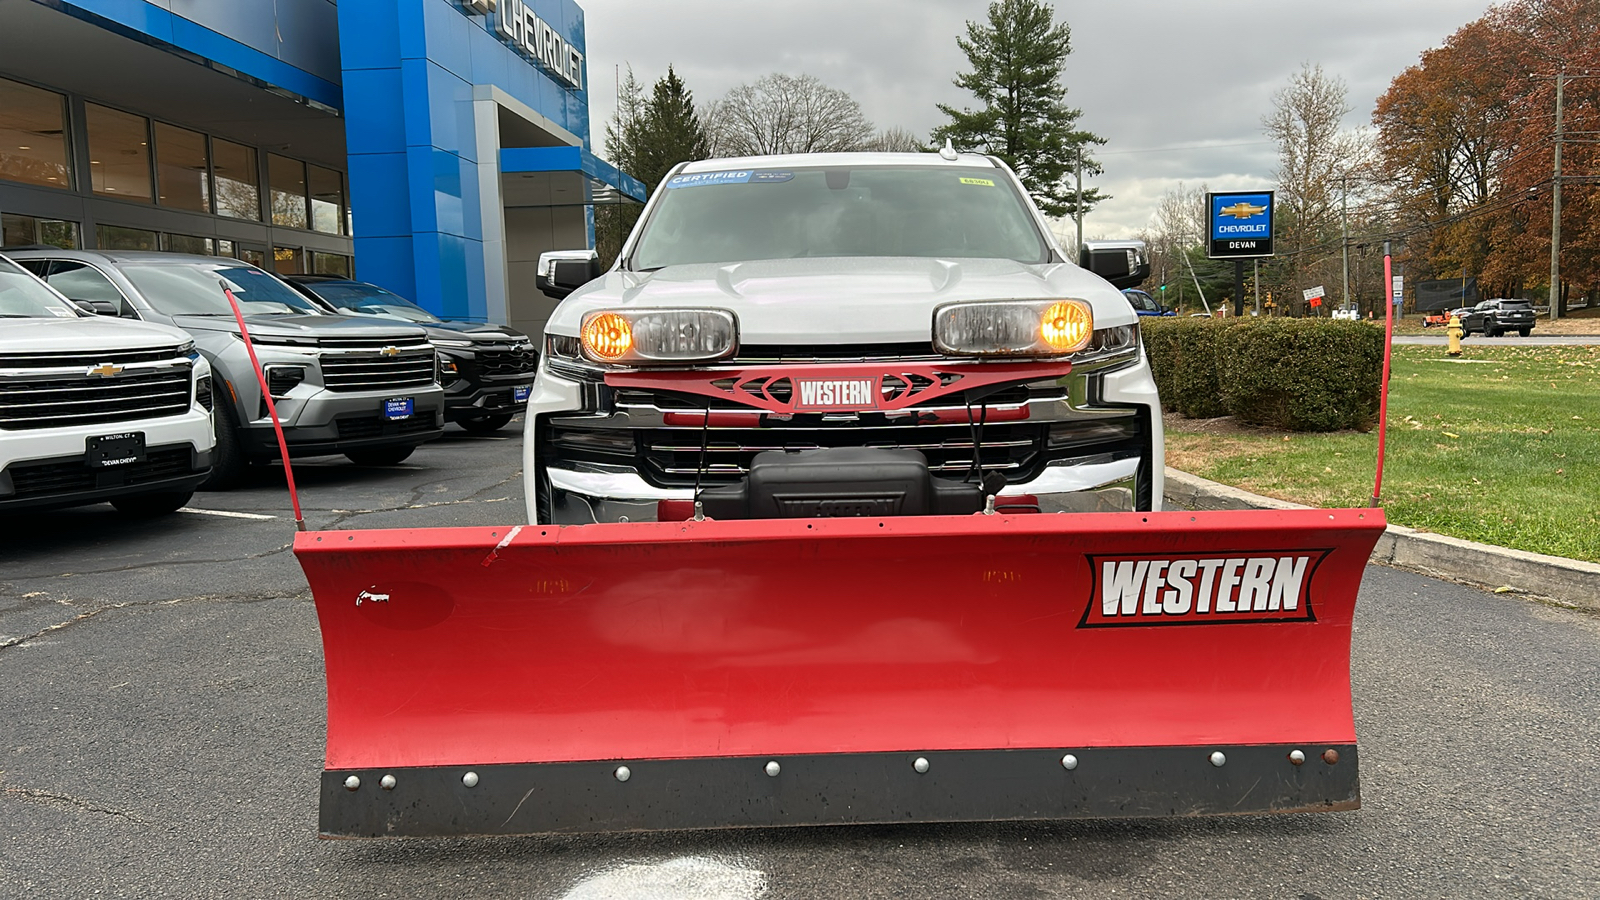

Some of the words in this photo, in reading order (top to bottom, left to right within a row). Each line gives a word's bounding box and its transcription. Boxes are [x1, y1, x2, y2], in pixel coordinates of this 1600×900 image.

[498, 0, 583, 90] CHEVROLET
[672, 172, 747, 184] CERTIFIED
[1218, 224, 1266, 233] CHEVROLET
[1229, 241, 1256, 249] DEVAN
[800, 380, 871, 405] WESTERN
[1102, 556, 1310, 616] WESTERN
